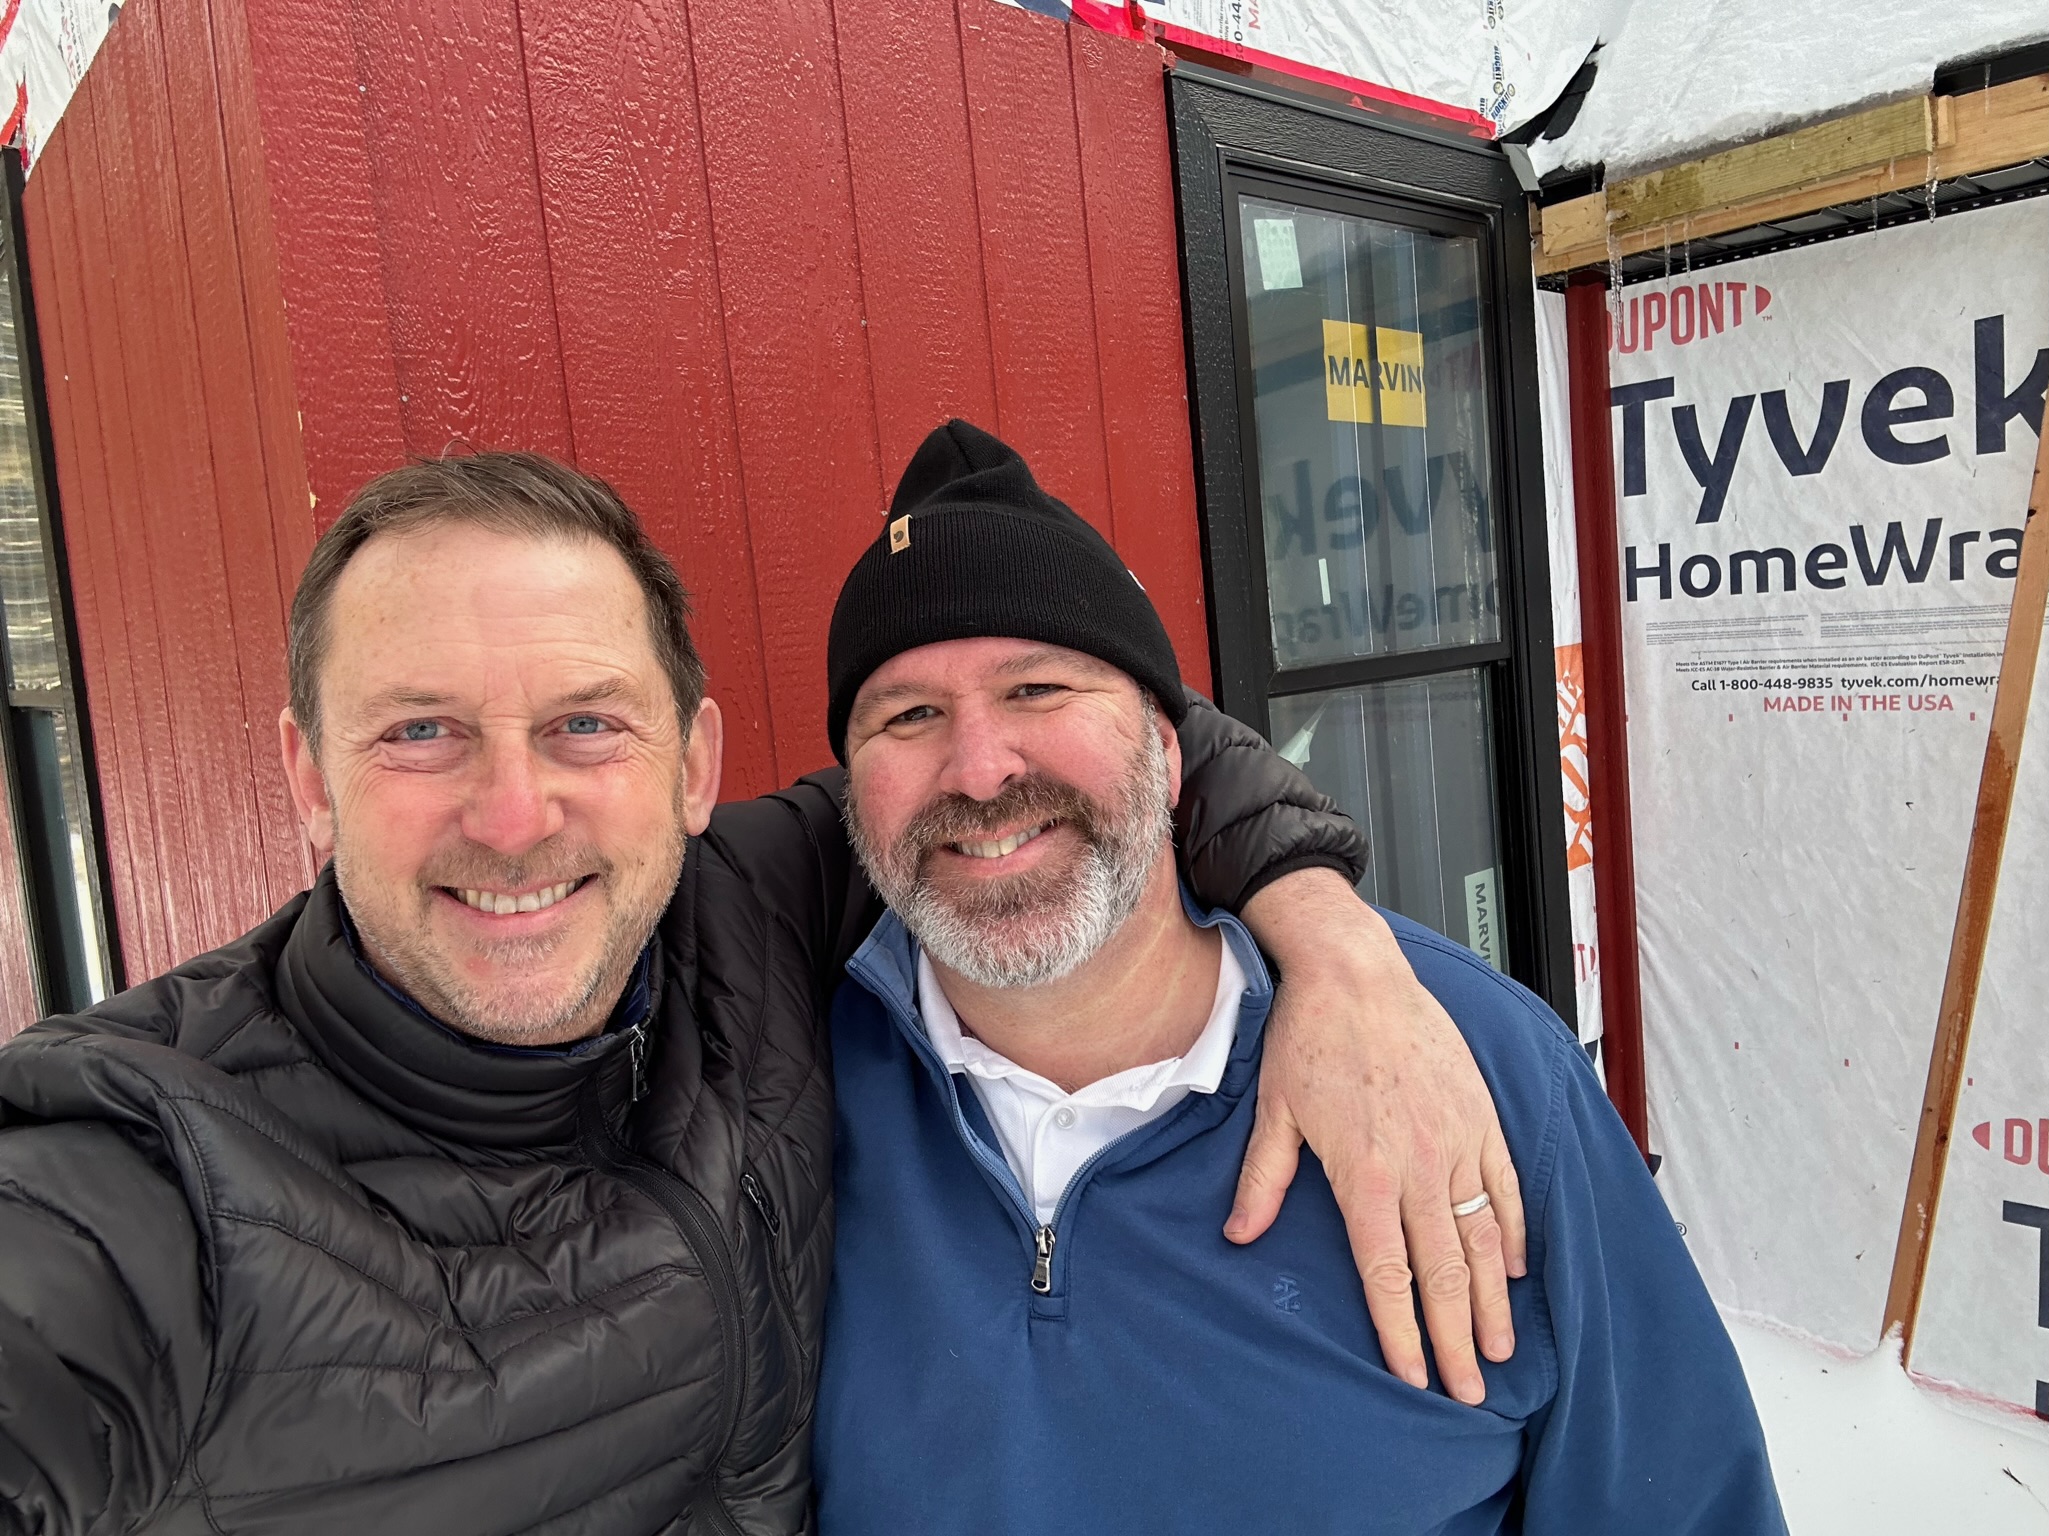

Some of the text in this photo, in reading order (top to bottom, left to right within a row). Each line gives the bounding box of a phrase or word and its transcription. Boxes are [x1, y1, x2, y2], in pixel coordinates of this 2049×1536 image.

[1611, 314, 2049, 524] Tyvek
[1626, 518, 2024, 602] HomeWra
[1691, 674, 2000, 691] Call 1-800-448-9835 tyvek.com/homewr
[1764, 694, 1954, 712] MADE IN THE USA
[1475, 882, 1491, 965] MARVI
